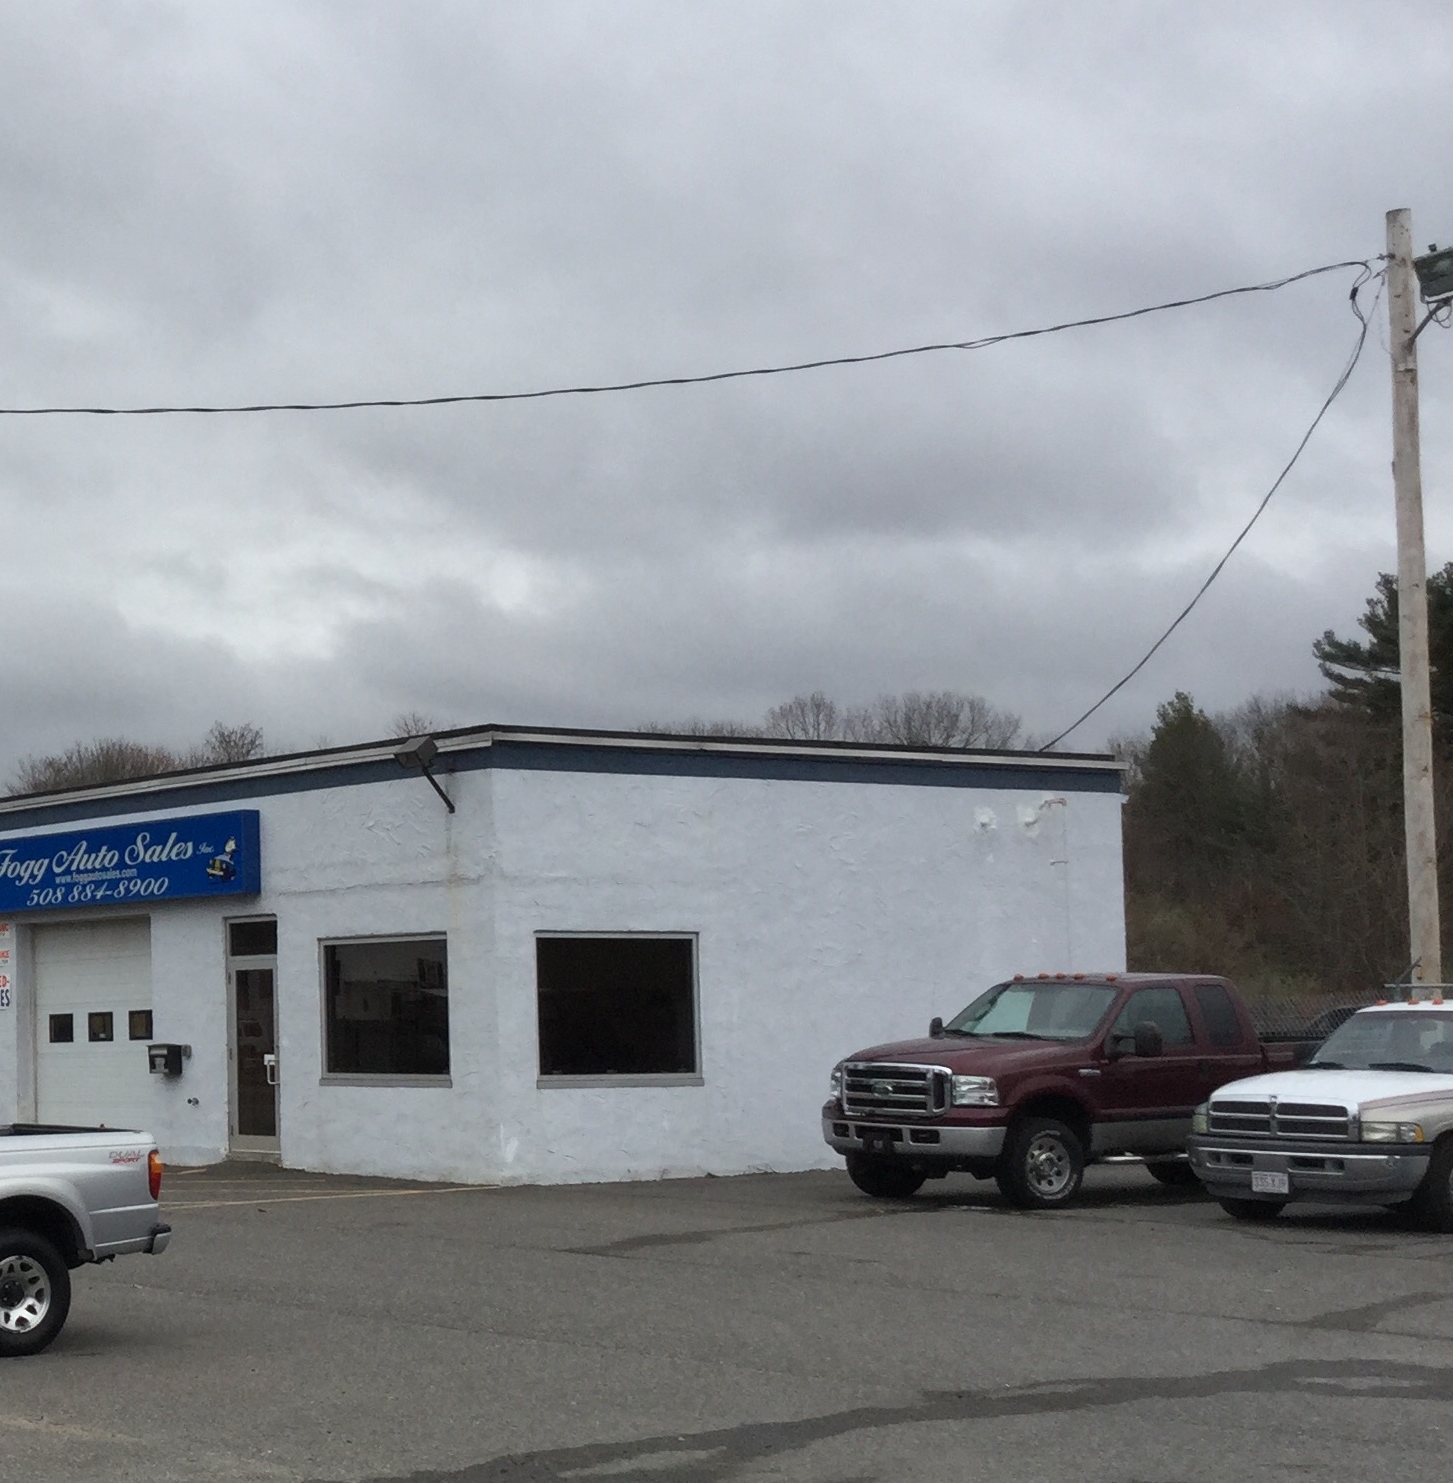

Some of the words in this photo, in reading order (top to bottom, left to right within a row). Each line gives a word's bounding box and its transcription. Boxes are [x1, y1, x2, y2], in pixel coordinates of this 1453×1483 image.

[52, 840, 119, 873] Auto
[124, 832, 194, 865] Sales
[27, 887, 65, 906] 508
[67, 877, 169, 902] 884-8900
